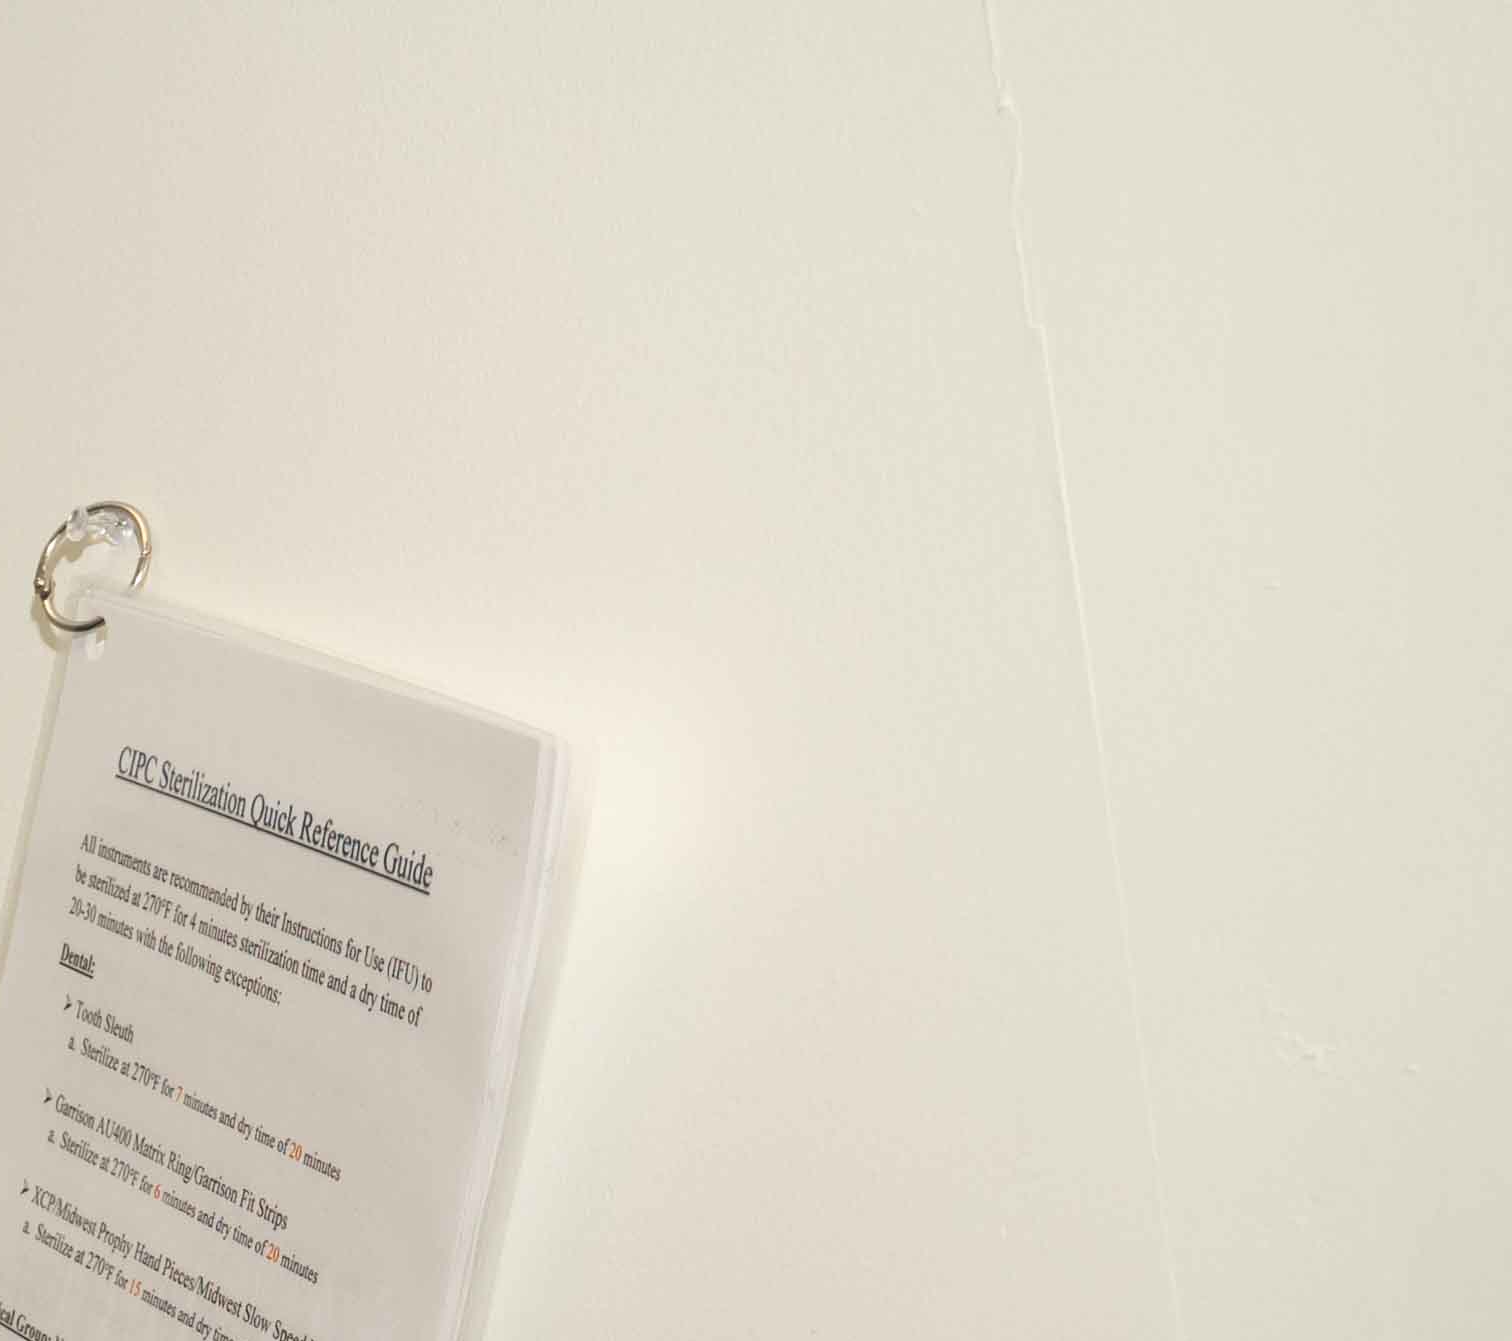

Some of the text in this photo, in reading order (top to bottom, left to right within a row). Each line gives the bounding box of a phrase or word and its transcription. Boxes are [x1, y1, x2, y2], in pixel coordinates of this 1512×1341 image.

[119, 746, 432, 888] CIPC Sterilization Quick Reference Guide
[59, 943, 95, 979] Dental:
[69, 897, 97, 923] 20-30
[97, 912, 133, 939] minutes
[137, 928, 156, 950] with
[159, 936, 173, 957] the
[175, 942, 222, 983] following
[76, 864, 86, 884] be
[88, 875, 131, 902] sterilized
[131, 893, 141, 907] at
[173, 905, 188, 927] for
[190, 913, 197, 930] 4
[198, 918, 237, 948] minutes
[239, 937, 299, 974] sterilization
[302, 960, 325, 985] time
[327, 975, 348, 995] and
[350, 985, 356, 999] a
[359, 984, 377, 1011] dry
[380, 993, 405, 1019] time
[408, 1006, 423, 1027] of
[80, 834, 432, 992] All instruments are recommended by their Instructions for Use (IFU) to
[77, 1000, 133, 1043] Tooth Sleuth
[56, 1094, 287, 1231] Garrison AU400 Matrix Ring/Garrison Fit Strips
[81, 1038, 119, 1071] Sterilize
[120, 1062, 130, 1077] at
[161, 1079, 175, 1098] for
[183, 1093, 218, 1120] minutes
[219, 1112, 237, 1129] and
[237, 1117, 253, 1140] dry
[255, 1125, 275, 1148] time
[277, 1138, 290, 1155] of
[289, 1142, 302, 1161] 20
[303, 1152, 341, 1181] minutes
[35, 1224, 73, 1258] Sterilize
[74, 1251, 85, 1265] at
[114, 1270, 128, 1289] for
[130, 1279, 142, 1296] 15
[141, 1289, 176, 1317] minutes
[178, 1311, 196, 1328] and
[196, 1318, 212, 1340] dry
[97, 1222, 133, 1259] Prophy
[134, 1242, 162, 1271] Hand
[162, 1258, 242, 1317] Pieces/Midwest
[243, 1303, 271, 1332] Slow
